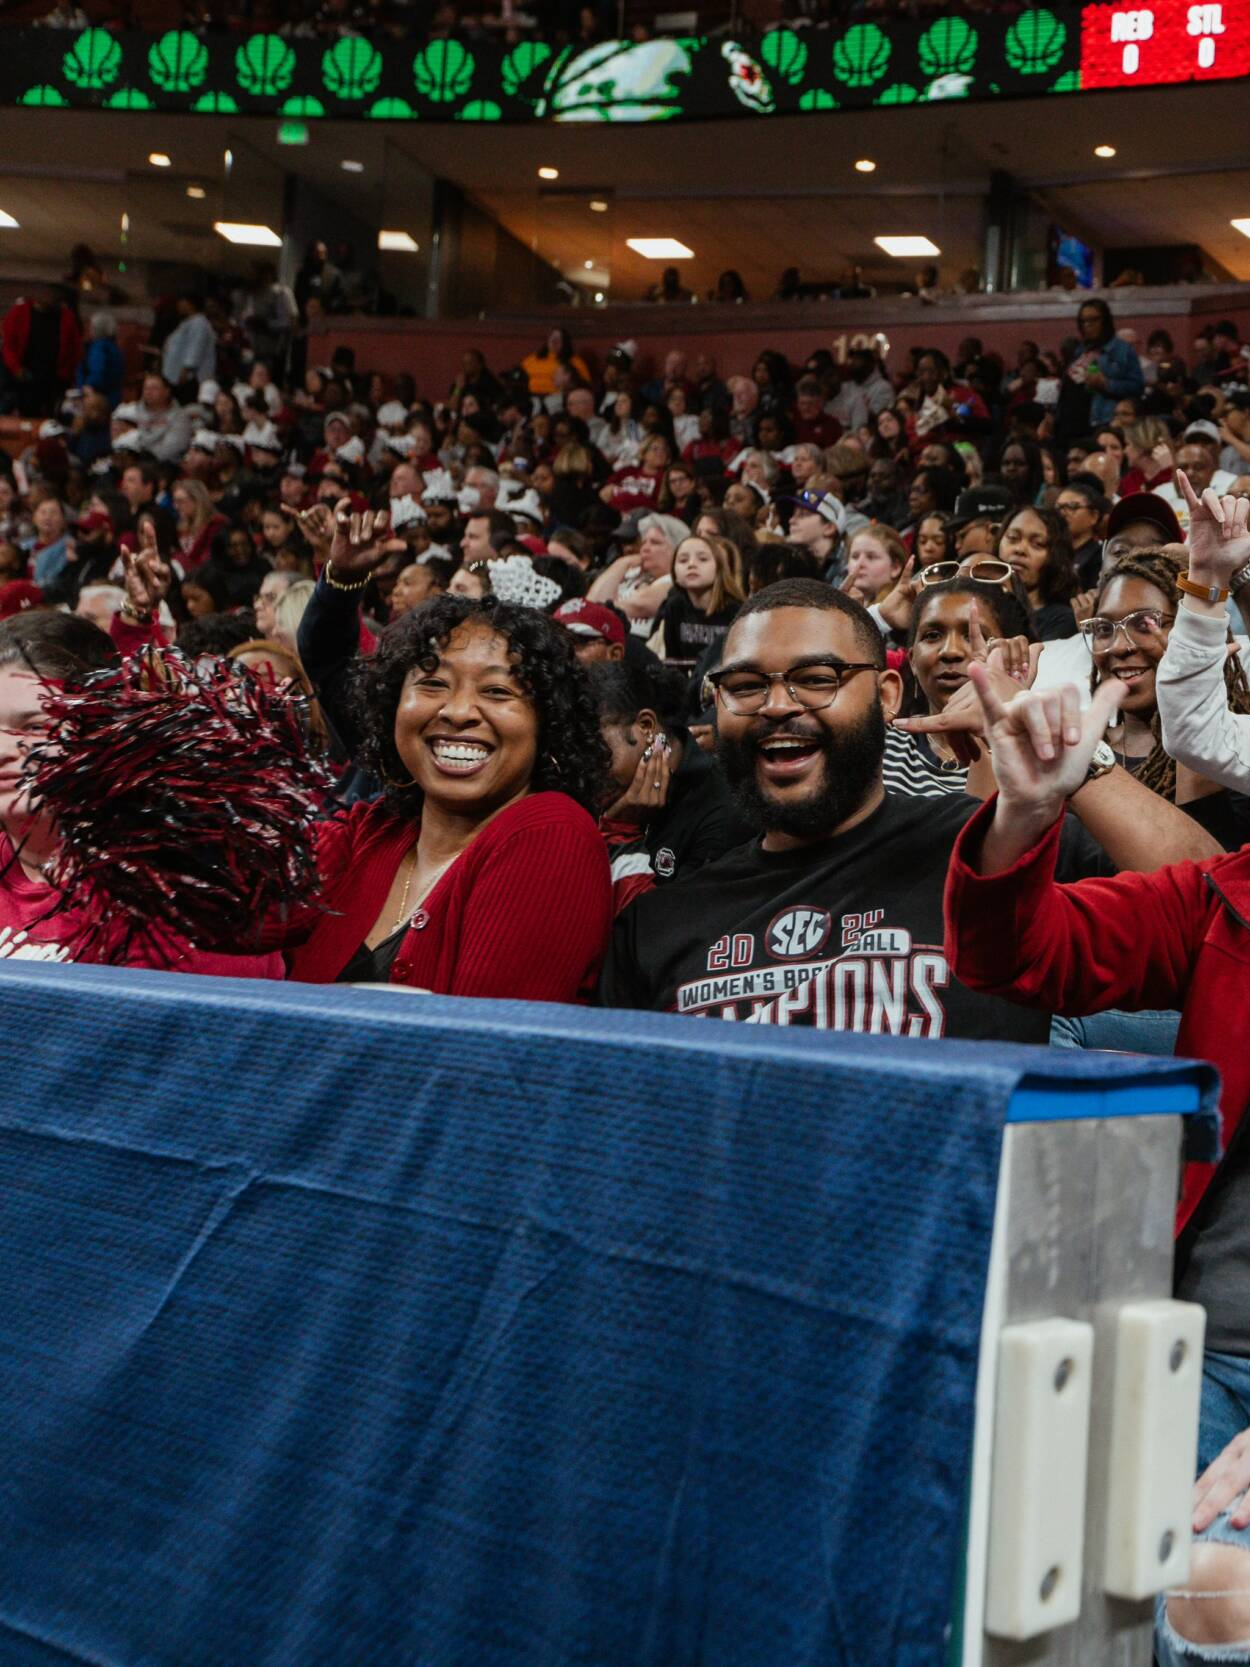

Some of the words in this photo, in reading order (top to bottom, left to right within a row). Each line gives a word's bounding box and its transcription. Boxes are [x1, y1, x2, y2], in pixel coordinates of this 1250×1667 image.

[1186, 4, 1226, 36] STL
[706, 934, 754, 971] 20
[770, 910, 826, 956] SEC
[682, 971, 776, 1008] WOMEN'S
